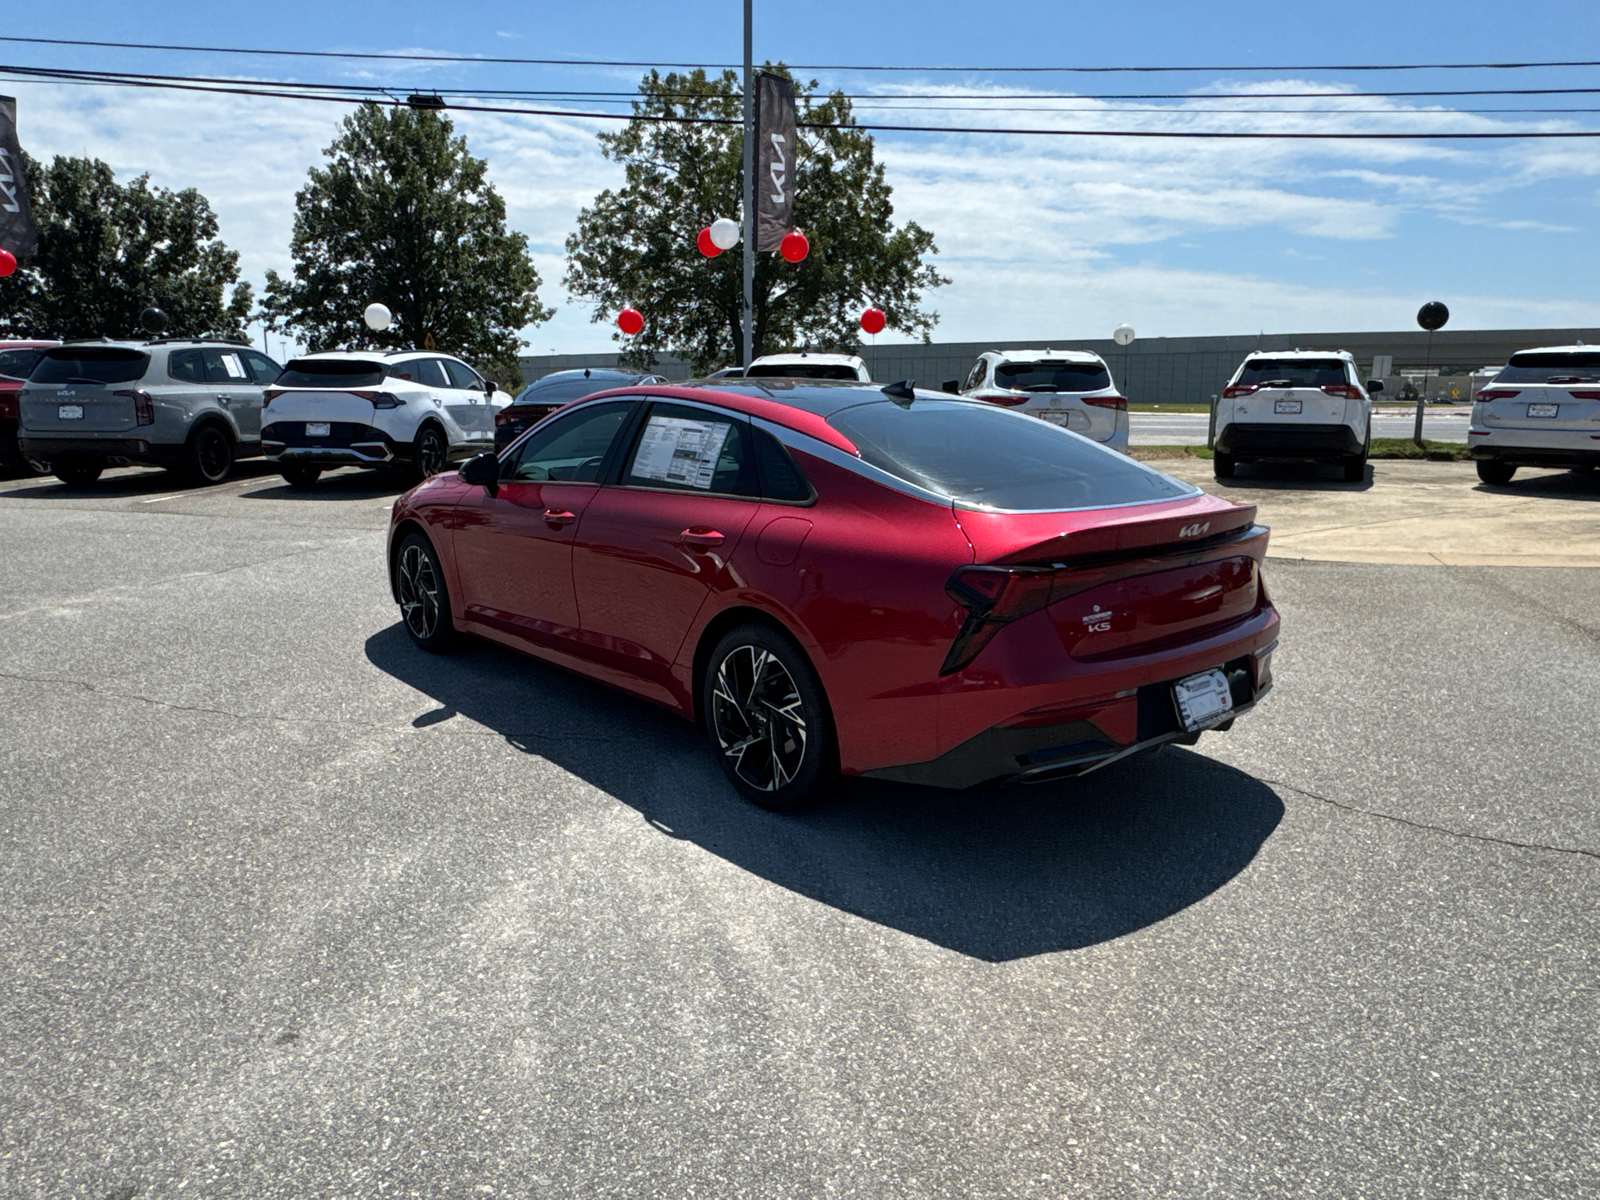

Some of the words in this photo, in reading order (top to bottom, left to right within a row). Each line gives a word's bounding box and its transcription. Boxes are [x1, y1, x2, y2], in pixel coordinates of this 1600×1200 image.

[770, 133, 786, 203] KIA
[1178, 521, 1211, 539] KIA
[1088, 622, 1111, 633] K5
